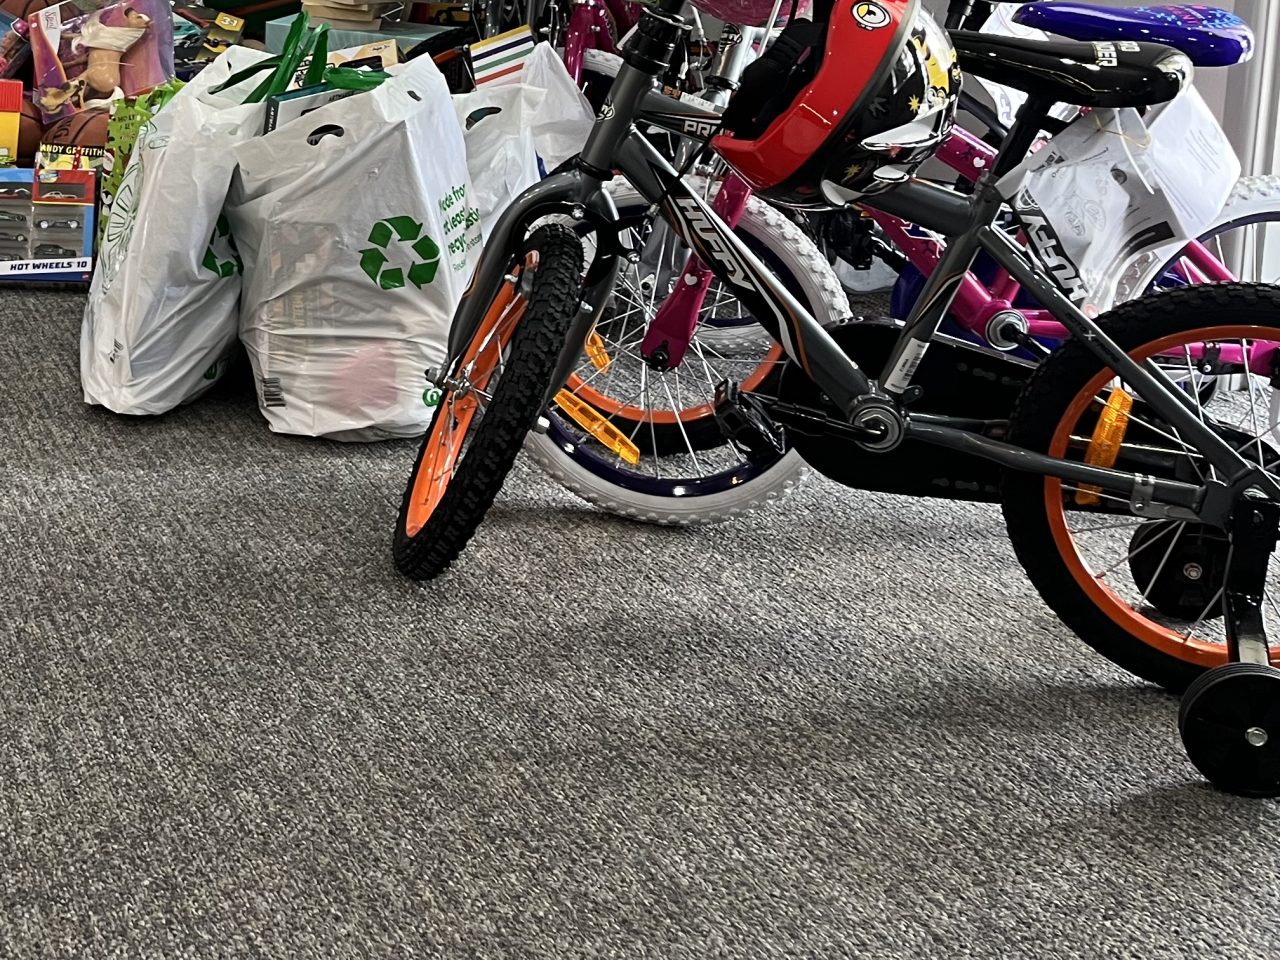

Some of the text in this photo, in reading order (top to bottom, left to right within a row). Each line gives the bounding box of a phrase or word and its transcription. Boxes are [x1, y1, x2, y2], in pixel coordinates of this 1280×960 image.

[40, 143, 64, 154] ANDY
[10, 260, 88, 271] HOT WHEELS 10
[675, 197, 757, 292] HUFFY
[1019, 213, 1090, 303] HUFFY
